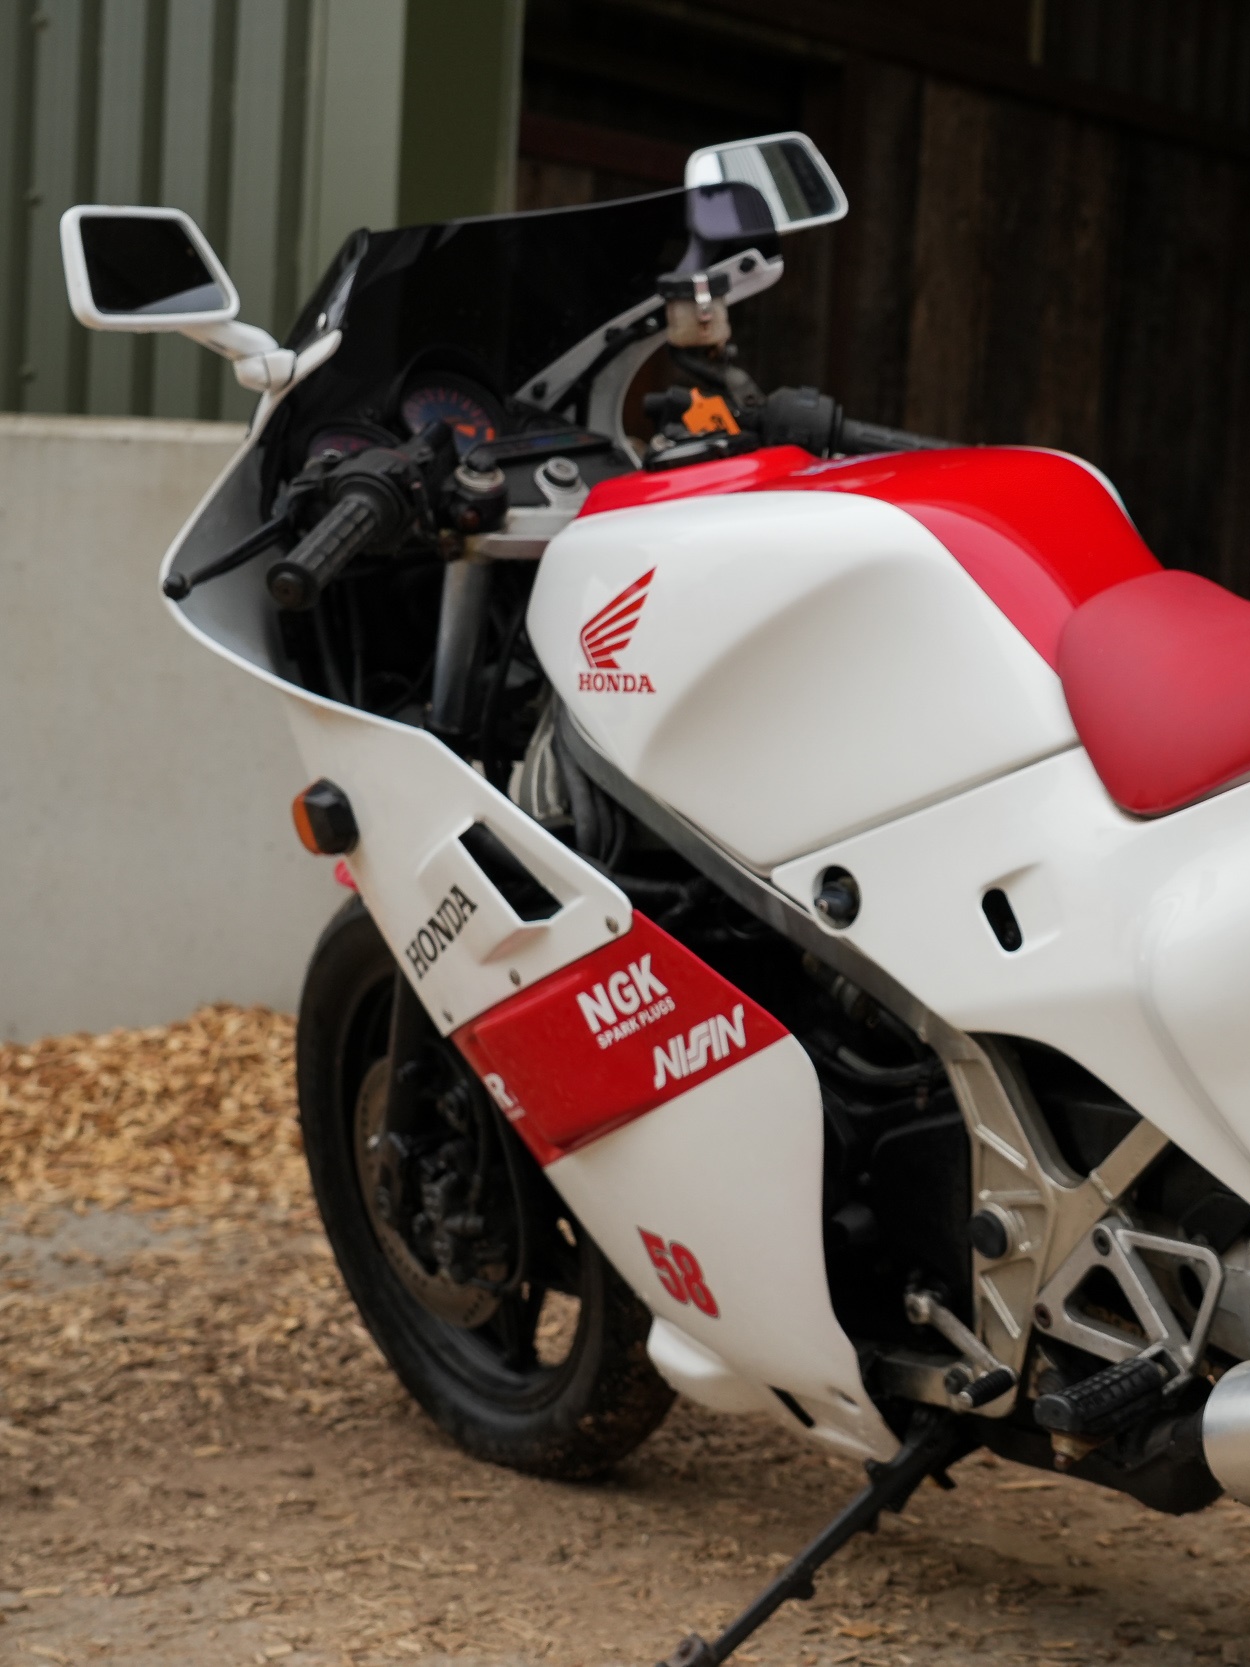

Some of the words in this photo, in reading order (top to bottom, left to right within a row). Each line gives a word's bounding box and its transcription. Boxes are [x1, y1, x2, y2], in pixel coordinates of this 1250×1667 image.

[579, 672, 656, 694] HONDA
[405, 884, 479, 980] HONDA
[576, 953, 668, 1034] NGK
[596, 1016, 641, 1050] SPARK
[637, 995, 676, 1027] PLUGS
[637, 1225, 721, 1319] 58
